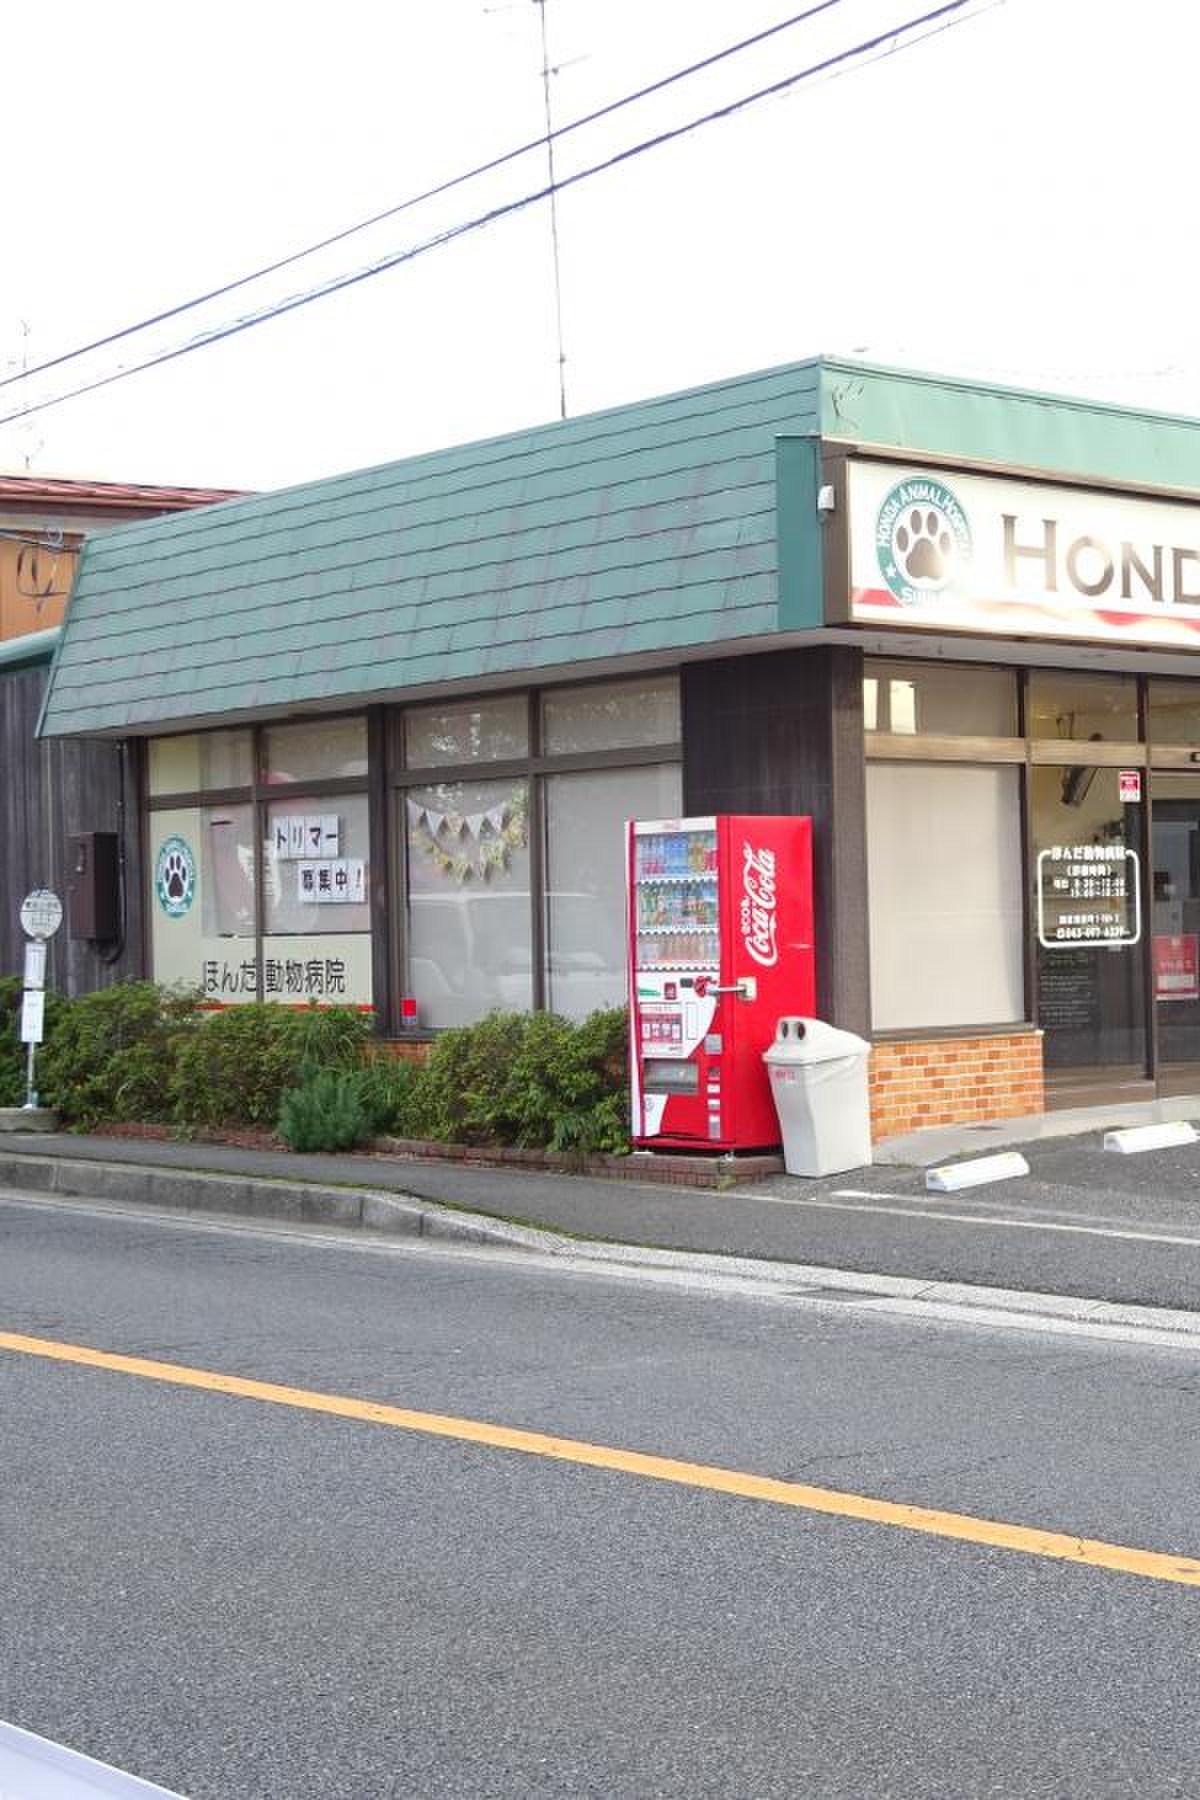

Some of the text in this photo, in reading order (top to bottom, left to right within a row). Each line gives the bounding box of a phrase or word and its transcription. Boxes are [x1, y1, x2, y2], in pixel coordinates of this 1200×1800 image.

[277, 826, 337, 850] トリマー
[201, 957, 346, 994] ほんだ動物病院
